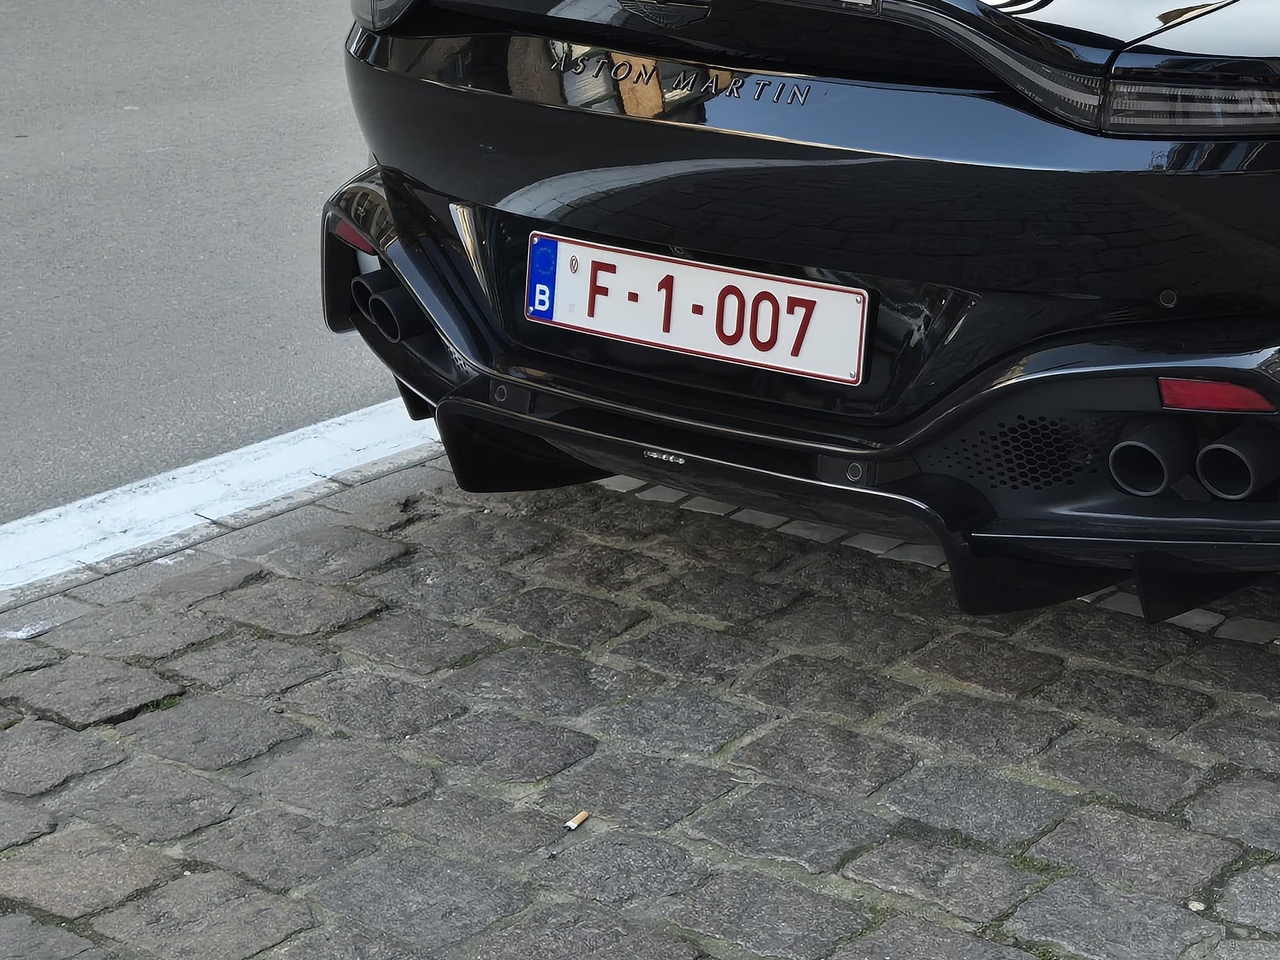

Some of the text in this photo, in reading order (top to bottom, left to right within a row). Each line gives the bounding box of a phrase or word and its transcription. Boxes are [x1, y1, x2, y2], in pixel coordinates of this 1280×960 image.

[550, 48, 812, 106] ASTON MARTIN
[533, 283, 551, 312] B
[586, 259, 818, 357] F-1-007
